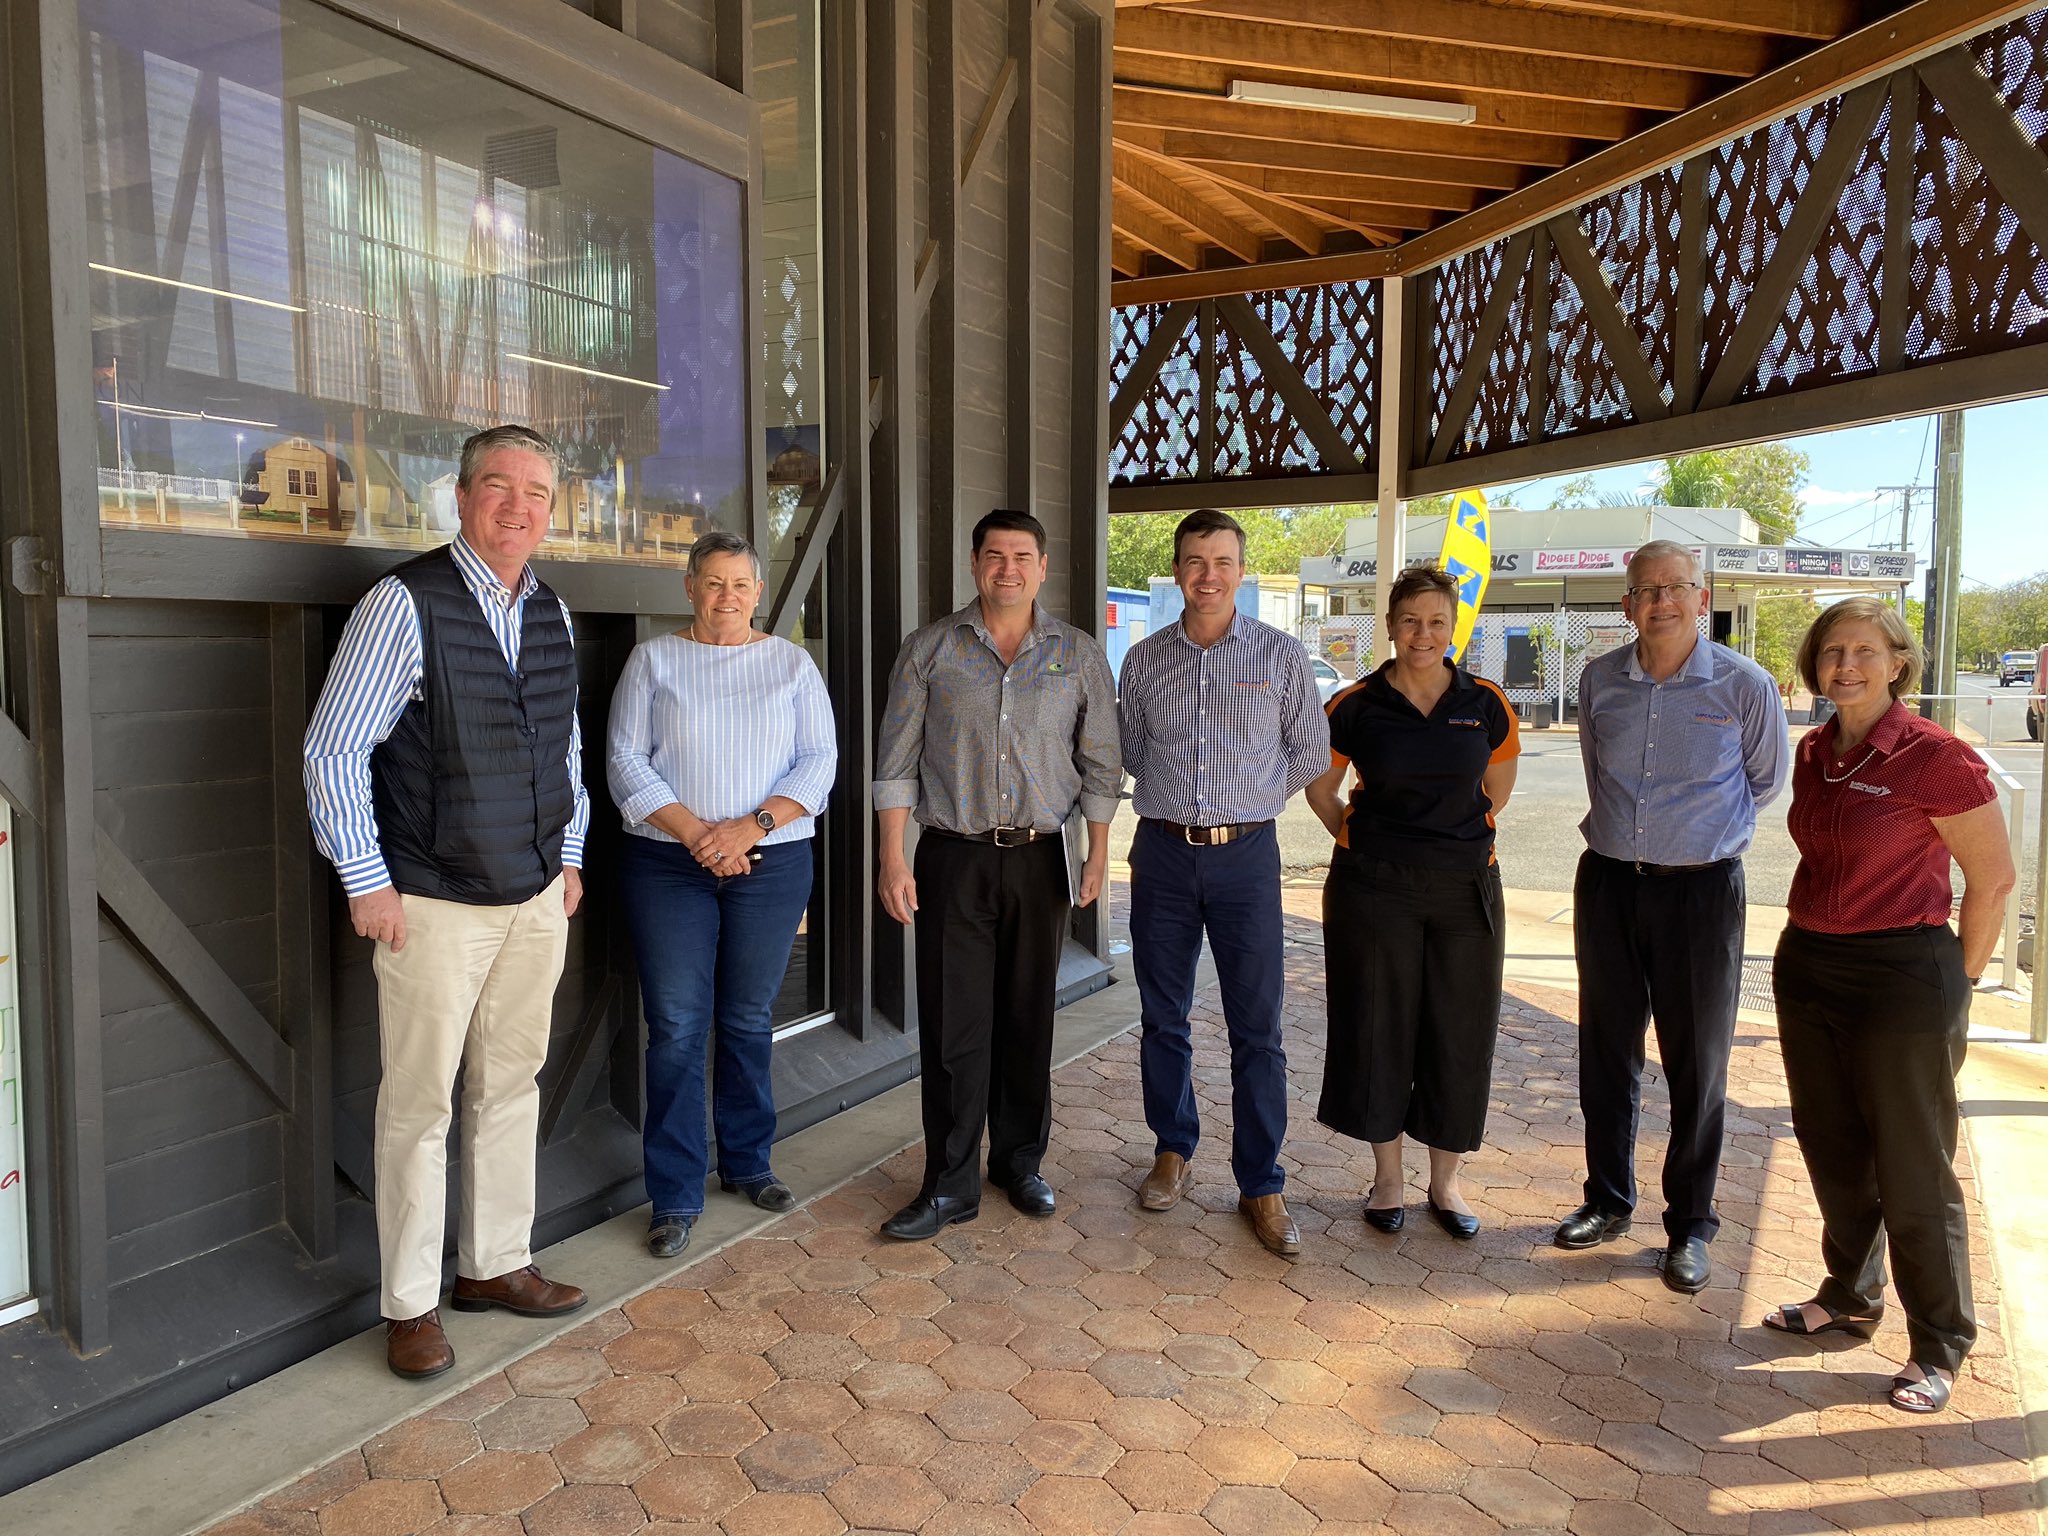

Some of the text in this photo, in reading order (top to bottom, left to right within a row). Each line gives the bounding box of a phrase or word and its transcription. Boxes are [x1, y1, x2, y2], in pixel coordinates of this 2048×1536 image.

[1717, 548, 1750, 558] ESPRESSO
[1538, 552, 1575, 568] RIDGEE
[1579, 551, 1610, 568] DIDGE
[1719, 560, 1744, 569] COFFEE
[1874, 556, 1907, 566] ESPRESSO
[1878, 567, 1902, 576] COFFEE
